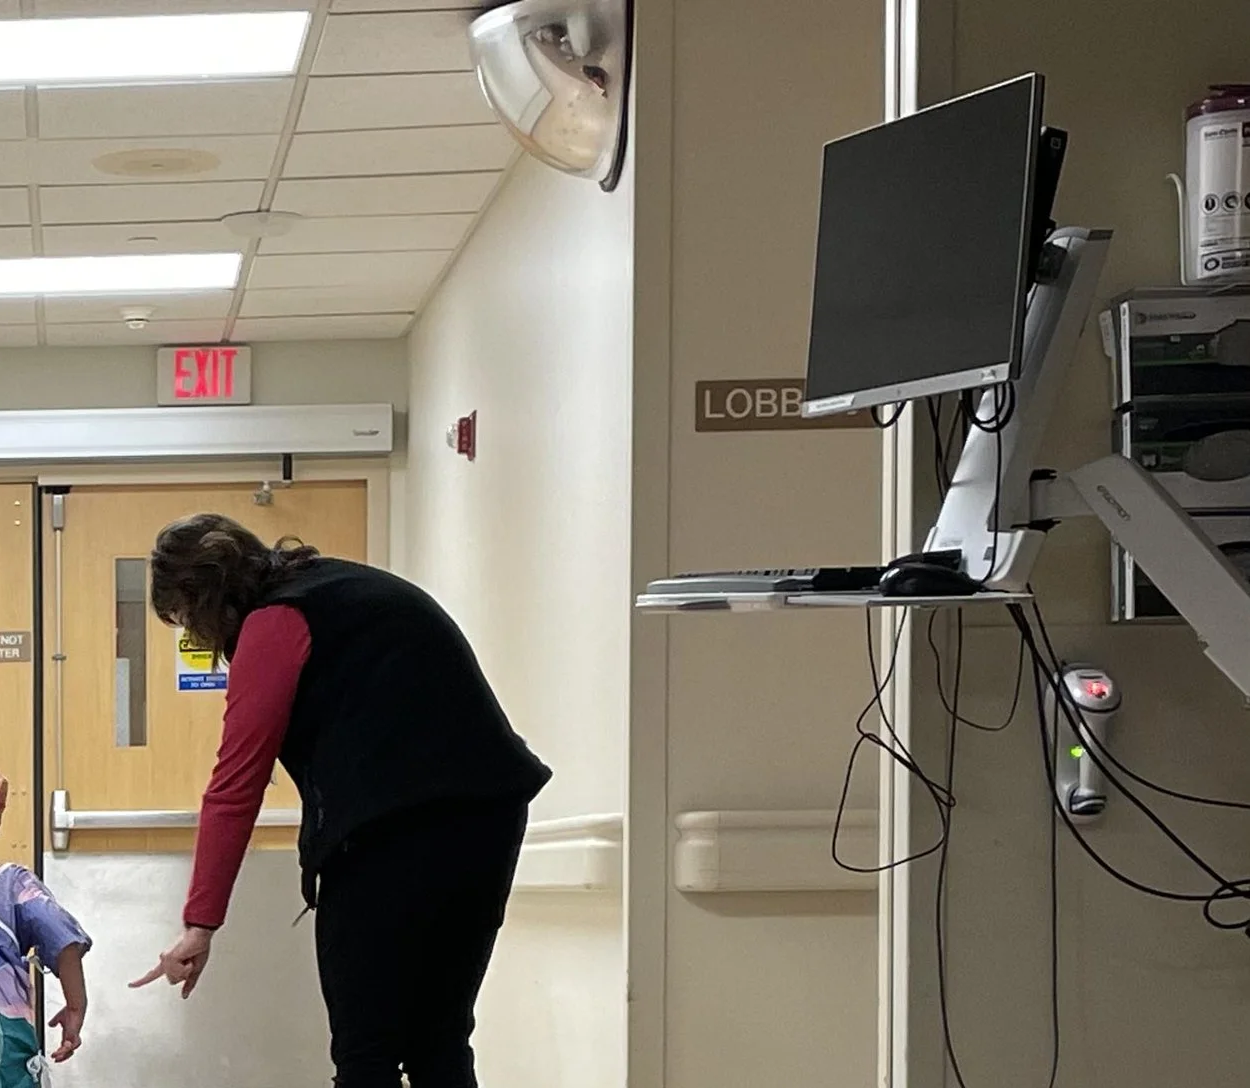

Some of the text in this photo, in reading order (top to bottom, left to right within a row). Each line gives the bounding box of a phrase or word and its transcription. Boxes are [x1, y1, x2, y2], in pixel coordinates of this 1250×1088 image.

[174, 349, 238, 398] EXIT
[705, 388, 803, 418] LOBB
[0, 635, 23, 645] NOT
